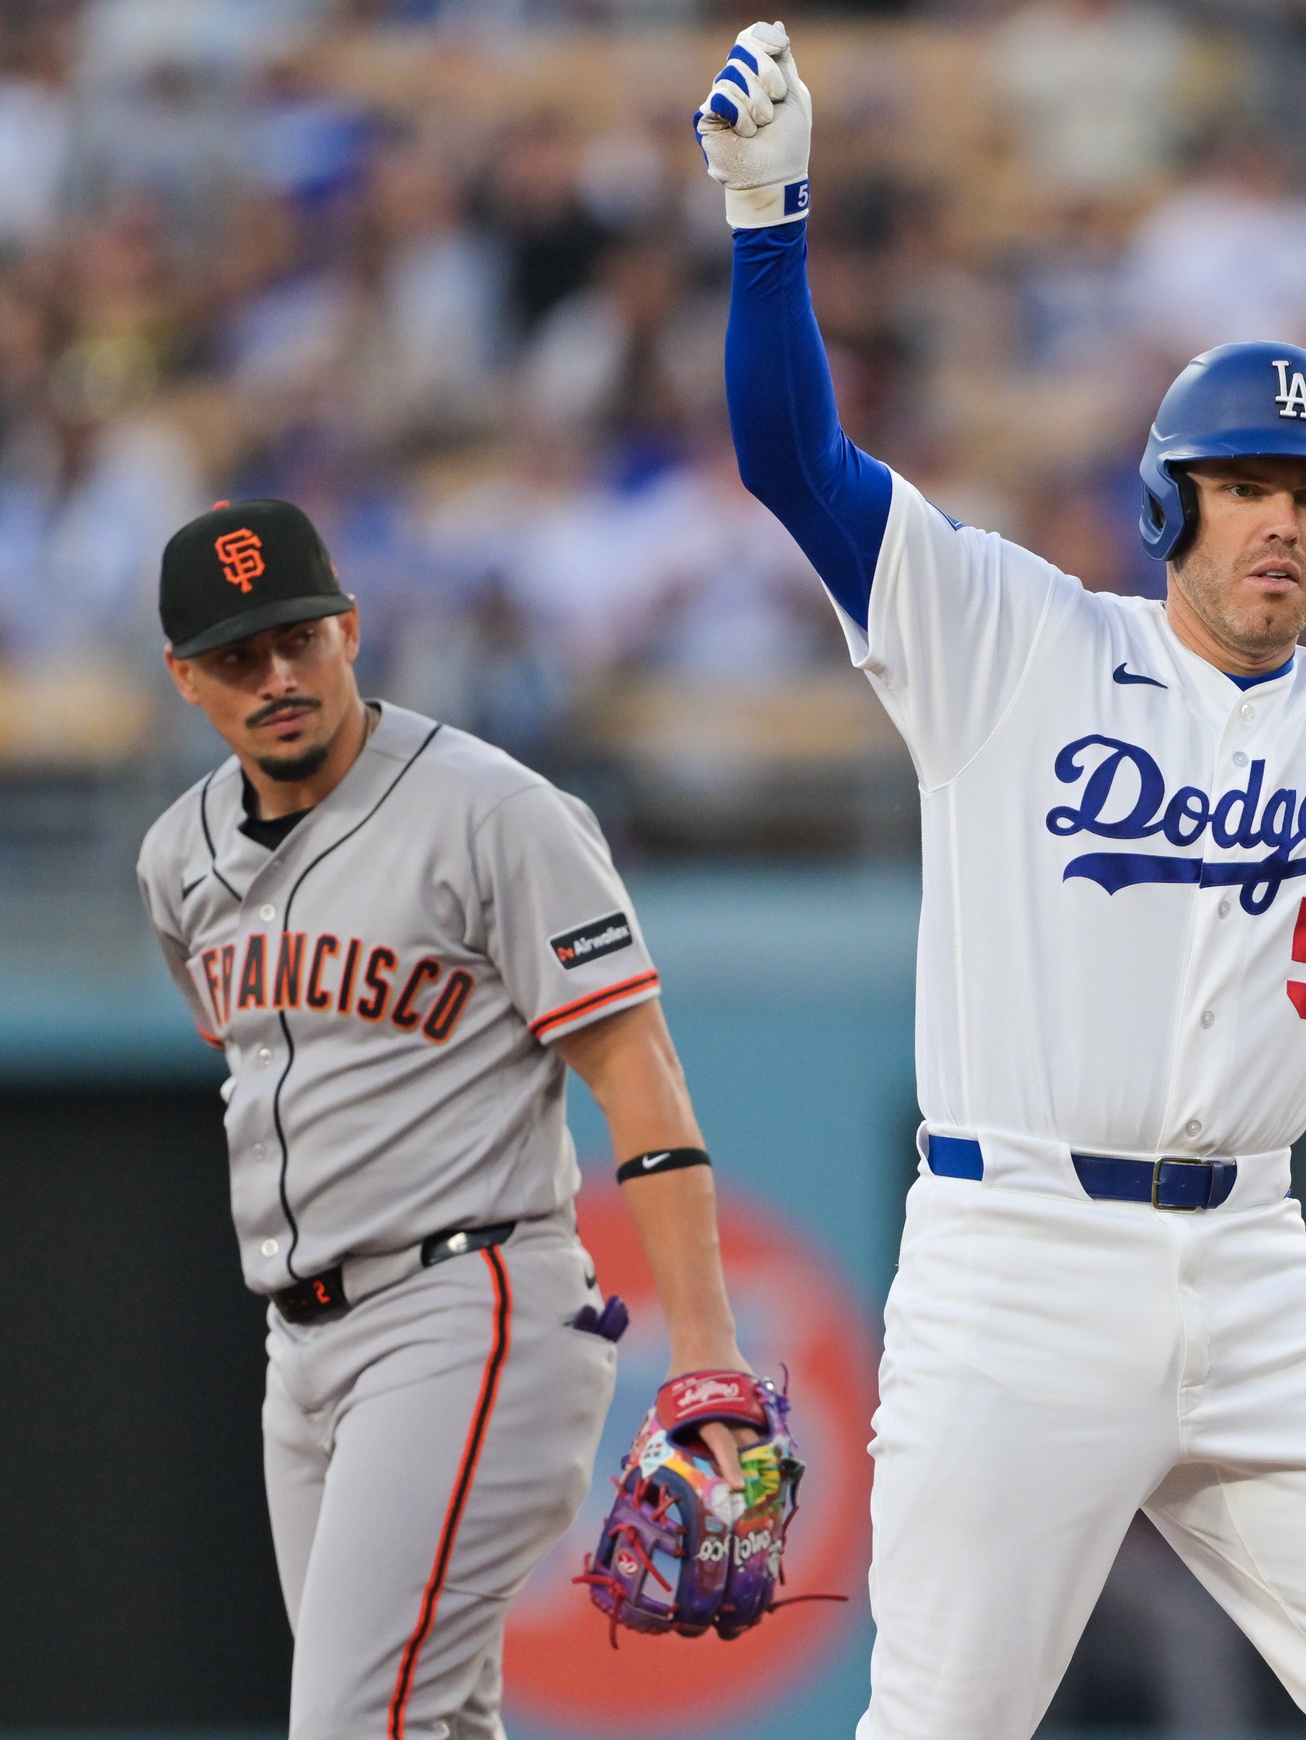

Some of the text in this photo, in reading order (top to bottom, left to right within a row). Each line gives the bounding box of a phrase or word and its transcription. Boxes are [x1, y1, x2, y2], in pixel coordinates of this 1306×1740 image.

[798, 184, 808, 207] 5
[214, 527, 265, 594] SF
[313, 1280, 330, 1304] 2
